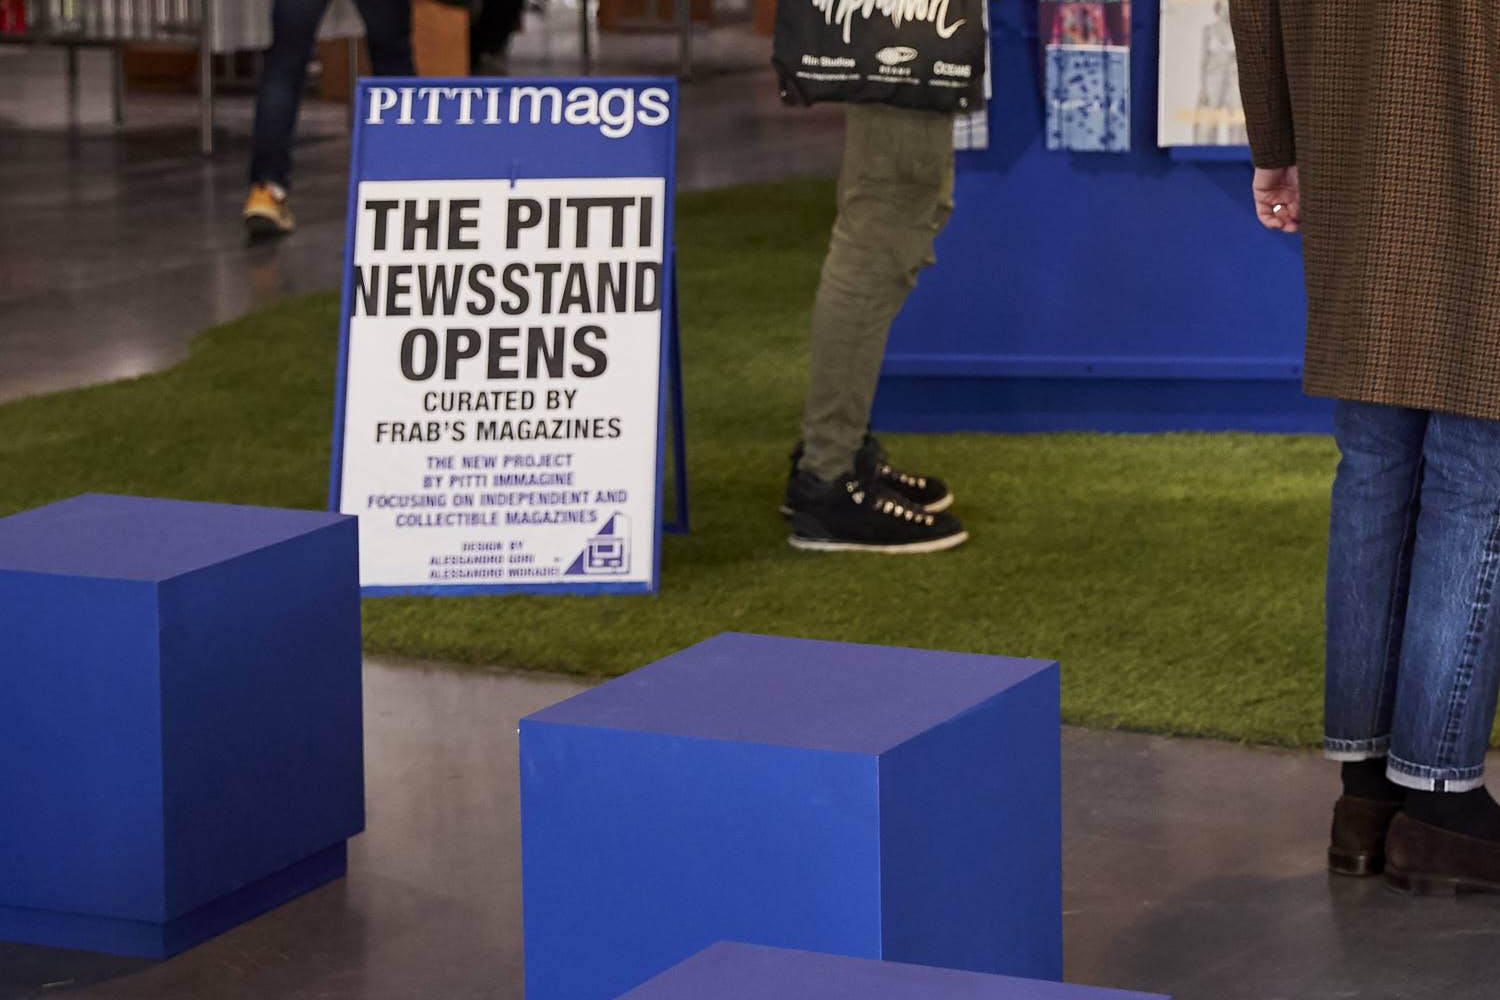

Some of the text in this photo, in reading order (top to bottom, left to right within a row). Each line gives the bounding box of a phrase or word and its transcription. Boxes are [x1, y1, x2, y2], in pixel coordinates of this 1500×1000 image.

[365, 196, 653, 251] THE PITTI
[352, 261, 662, 317] NEWSSTAND
[400, 325, 608, 382] OPENS
[423, 388, 578, 413] CURATED BY
[376, 417, 622, 444] FRAB'S MAGAZINES
[426, 453, 573, 470] THE NEW PROJECT
[423, 472, 574, 488] BY PITTI IMMAGINE
[368, 490, 628, 509] FOCUSING ON INDEPENDENT AND
[396, 510, 598, 528] COLLECTIBLE MAGAZINES
